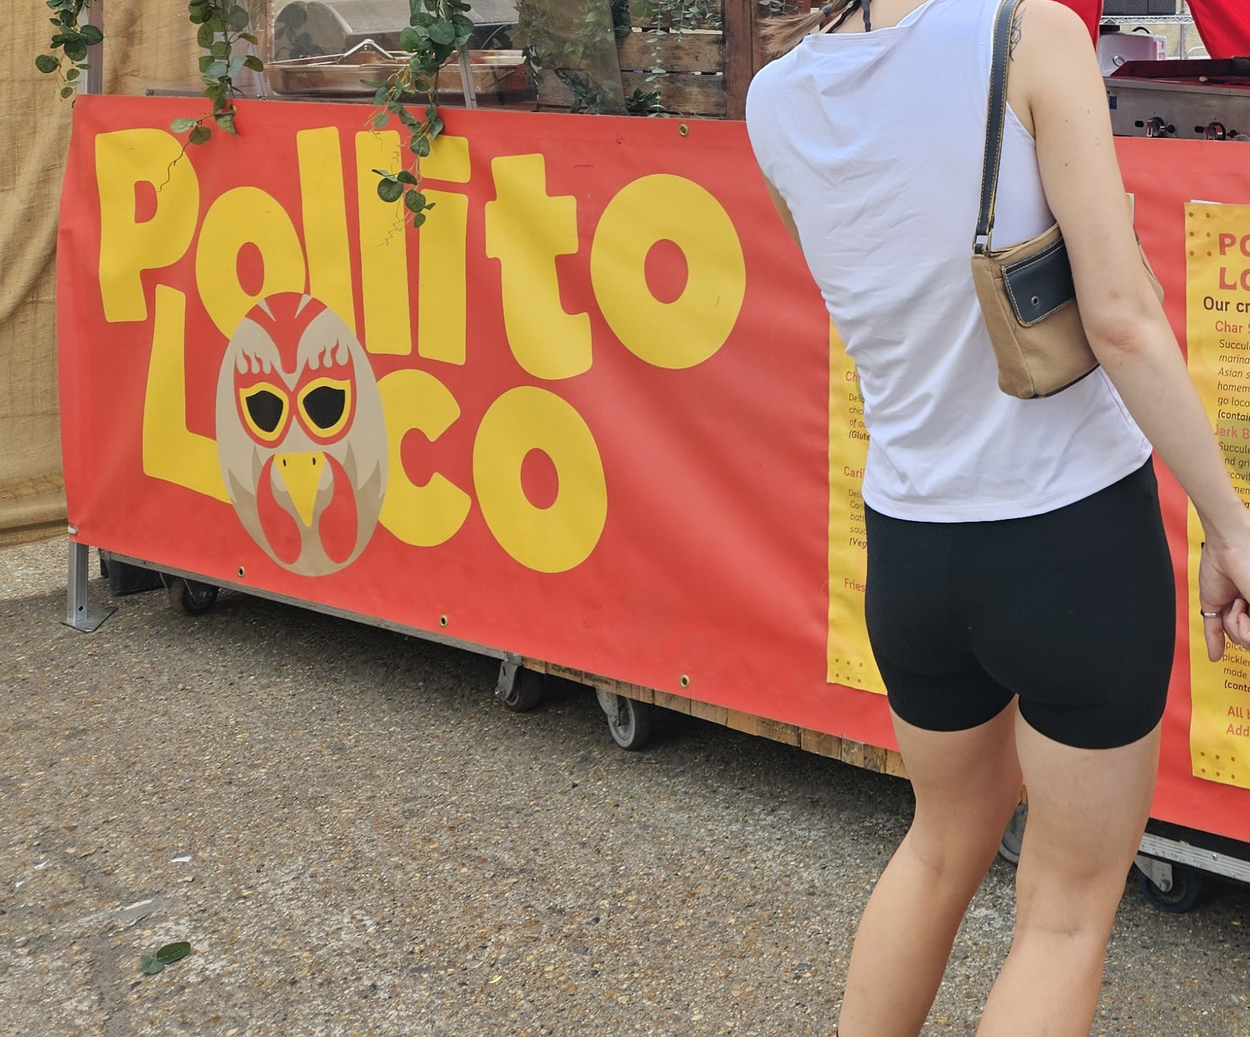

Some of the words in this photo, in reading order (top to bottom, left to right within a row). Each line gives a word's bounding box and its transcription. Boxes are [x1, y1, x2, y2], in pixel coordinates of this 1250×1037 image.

[1203, 296, 1230, 312] Our
[1215, 320, 1243, 333] Char
[1218, 367, 1243, 378] Asian
[1218, 397, 1229, 406] go
[1231, 396, 1250, 408] loco
[1214, 423, 1238, 438] Jerk
[1227, 706, 1243, 719] All
[1226, 723, 1250, 737] Add
